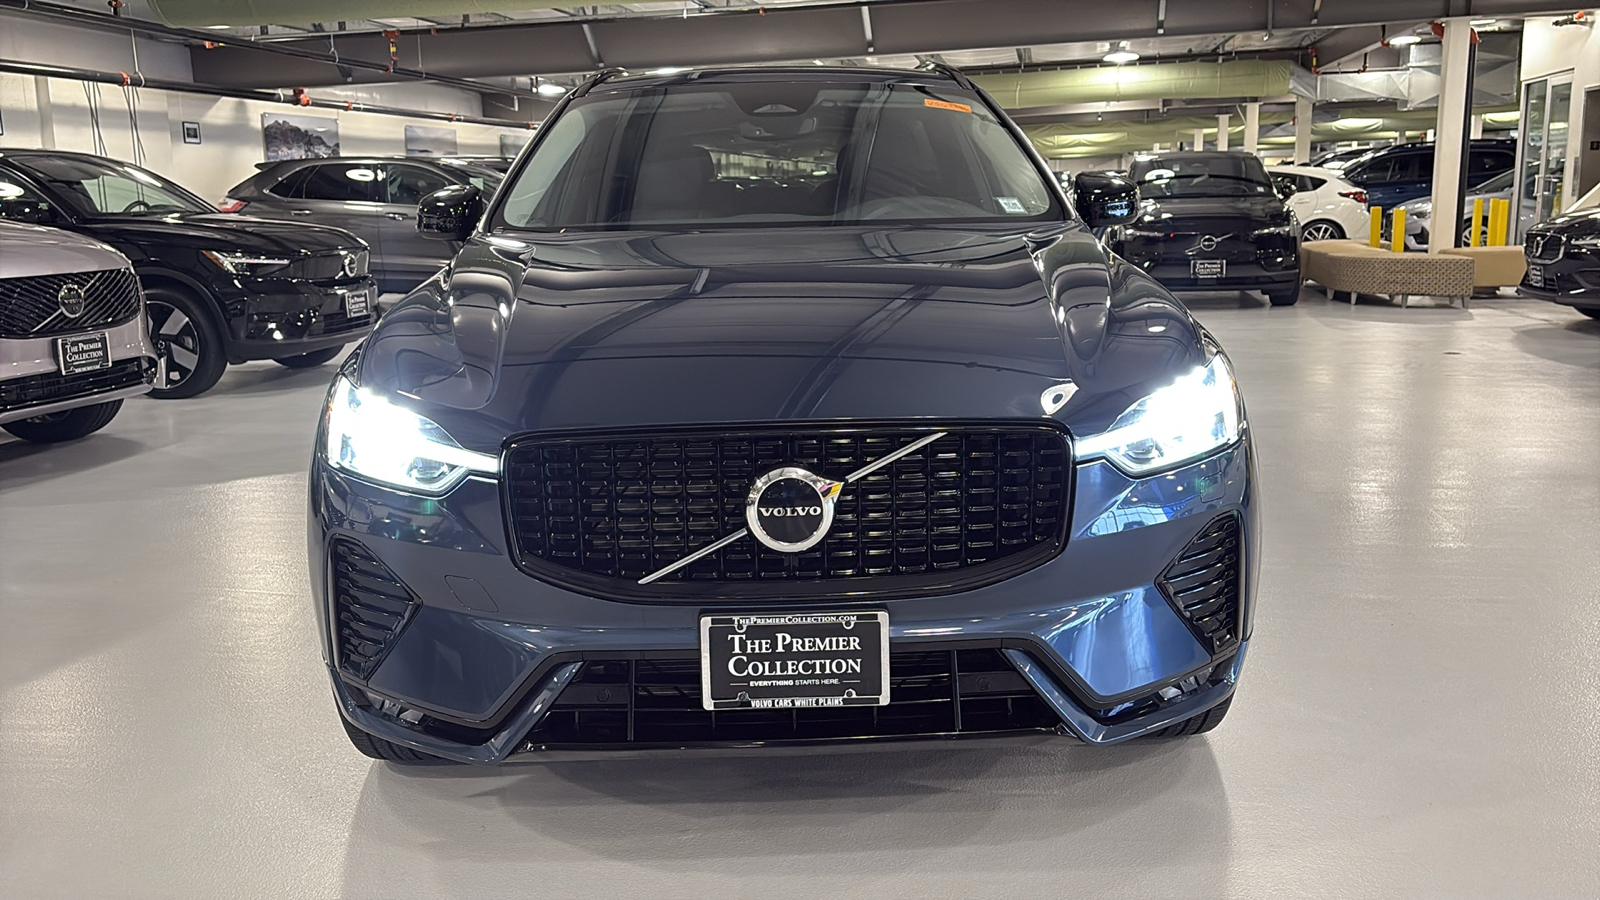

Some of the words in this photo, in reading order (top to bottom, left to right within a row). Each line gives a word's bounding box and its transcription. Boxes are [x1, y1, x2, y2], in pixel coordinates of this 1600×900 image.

[65, 344, 78, 353] THE
[78, 342, 102, 351] PREMIER
[66, 350, 103, 362] COLLECTION
[758, 506, 822, 517] VOLVO
[727, 634, 772, 654] THE
[775, 632, 862, 653] PREMIER
[727, 655, 862, 677] COLLECTION
[750, 699, 773, 708] VOLVO
[774, 699, 793, 708] CARS
[794, 698, 817, 707] WHITE
[818, 698, 844, 706] PLAINS
